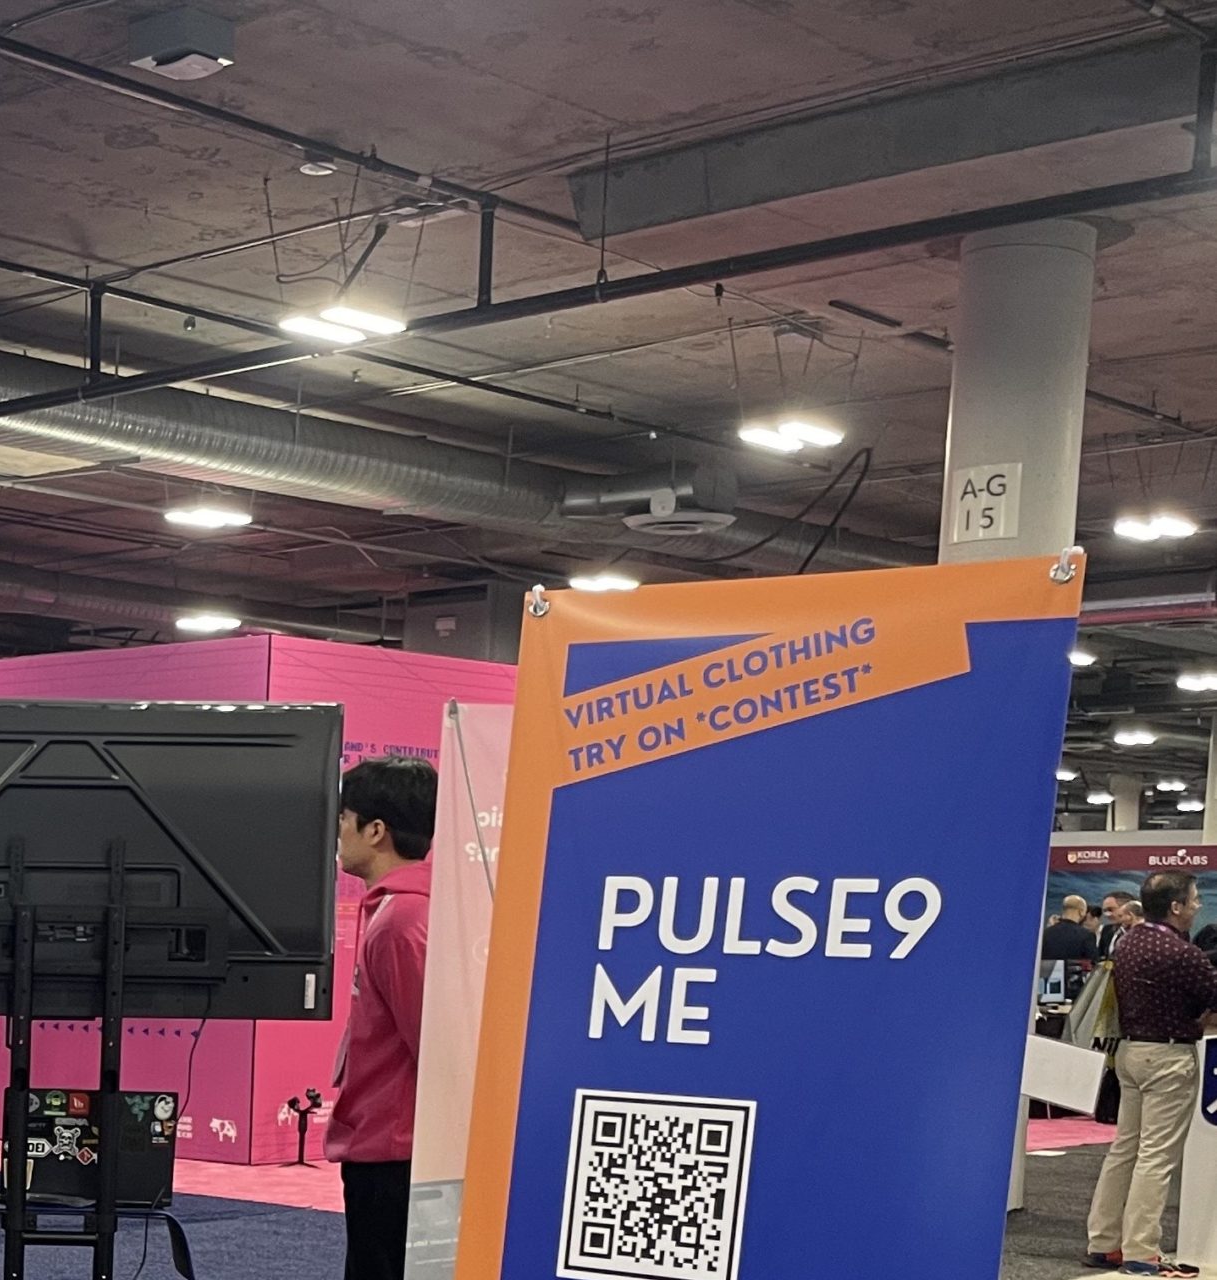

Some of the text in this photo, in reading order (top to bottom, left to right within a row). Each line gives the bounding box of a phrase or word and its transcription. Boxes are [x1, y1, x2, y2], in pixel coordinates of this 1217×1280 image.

[960, 473, 1007, 501] A-G
[564, 617, 877, 729] VIRTUAL CLOTHING
[568, 734, 627, 772] TRY
[638, 718, 685, 752] ON
[1077, 850, 1110, 859] KOREA
[598, 875, 943, 960] PULSE9
[588, 962, 718, 1045] ME
